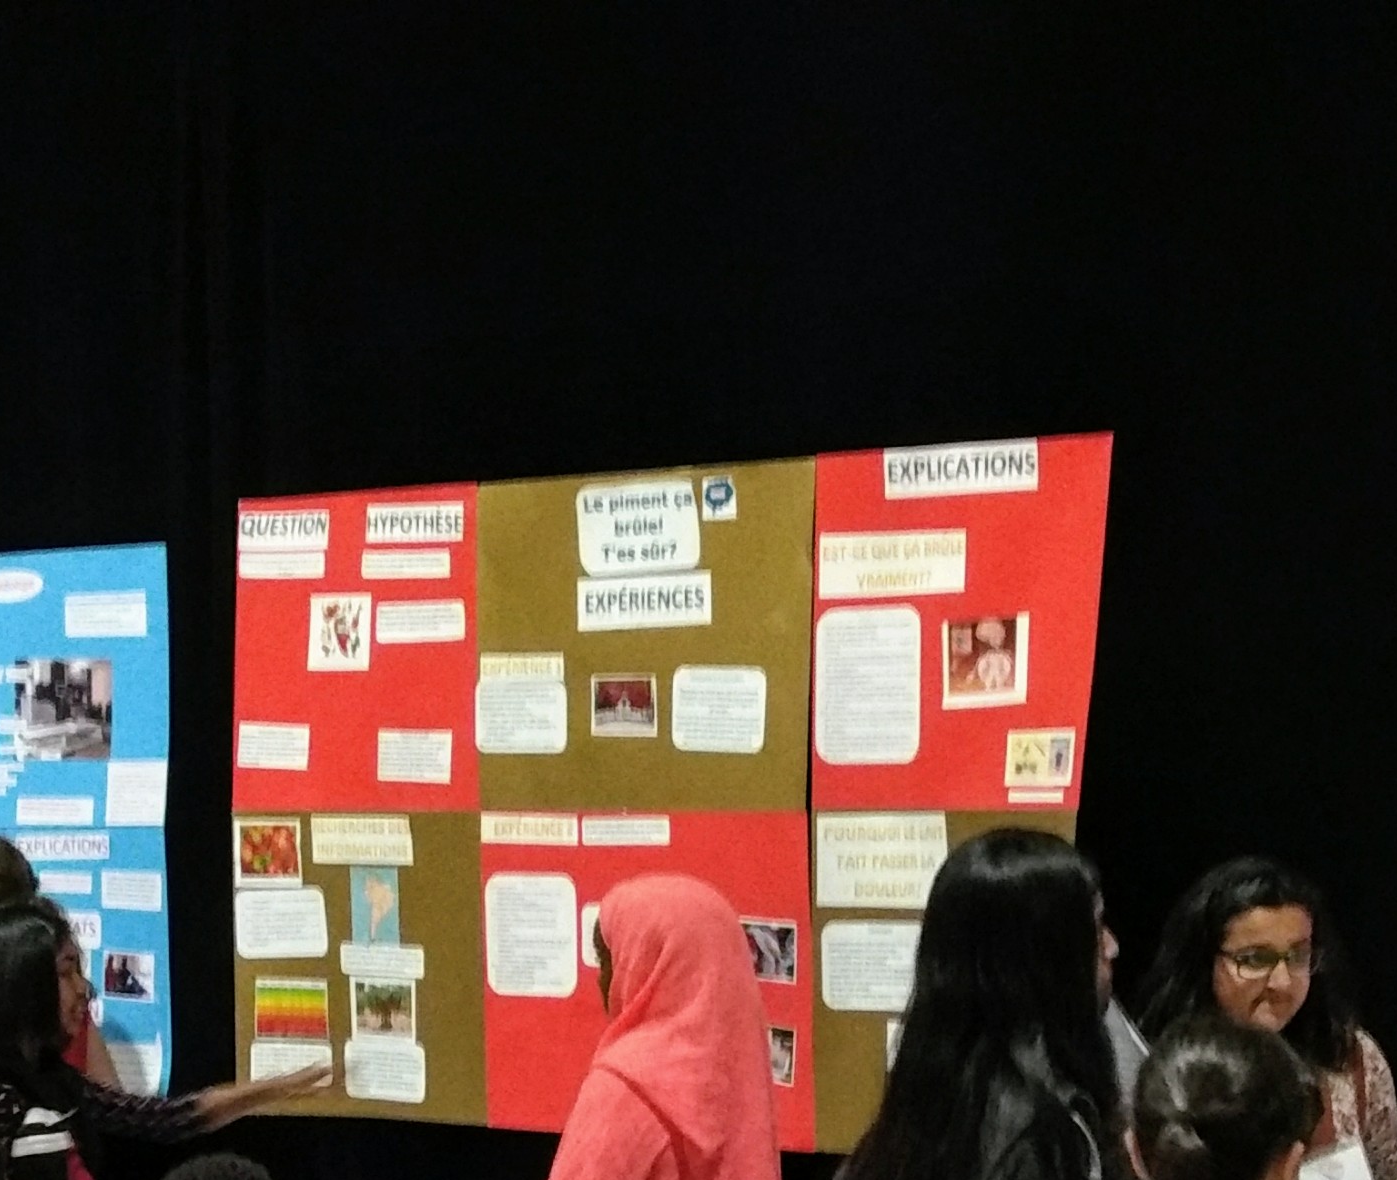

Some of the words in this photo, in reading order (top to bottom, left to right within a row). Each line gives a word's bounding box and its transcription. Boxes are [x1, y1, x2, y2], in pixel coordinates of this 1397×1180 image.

[888, 450, 1036, 484] EXPLICATIONS
[584, 495, 604, 513] Le
[609, 491, 667, 515] piment
[241, 512, 327, 537] QUESTION
[367, 506, 462, 535] HYPOTHÈSE
[585, 584, 704, 614] EXPÉRIENCES
